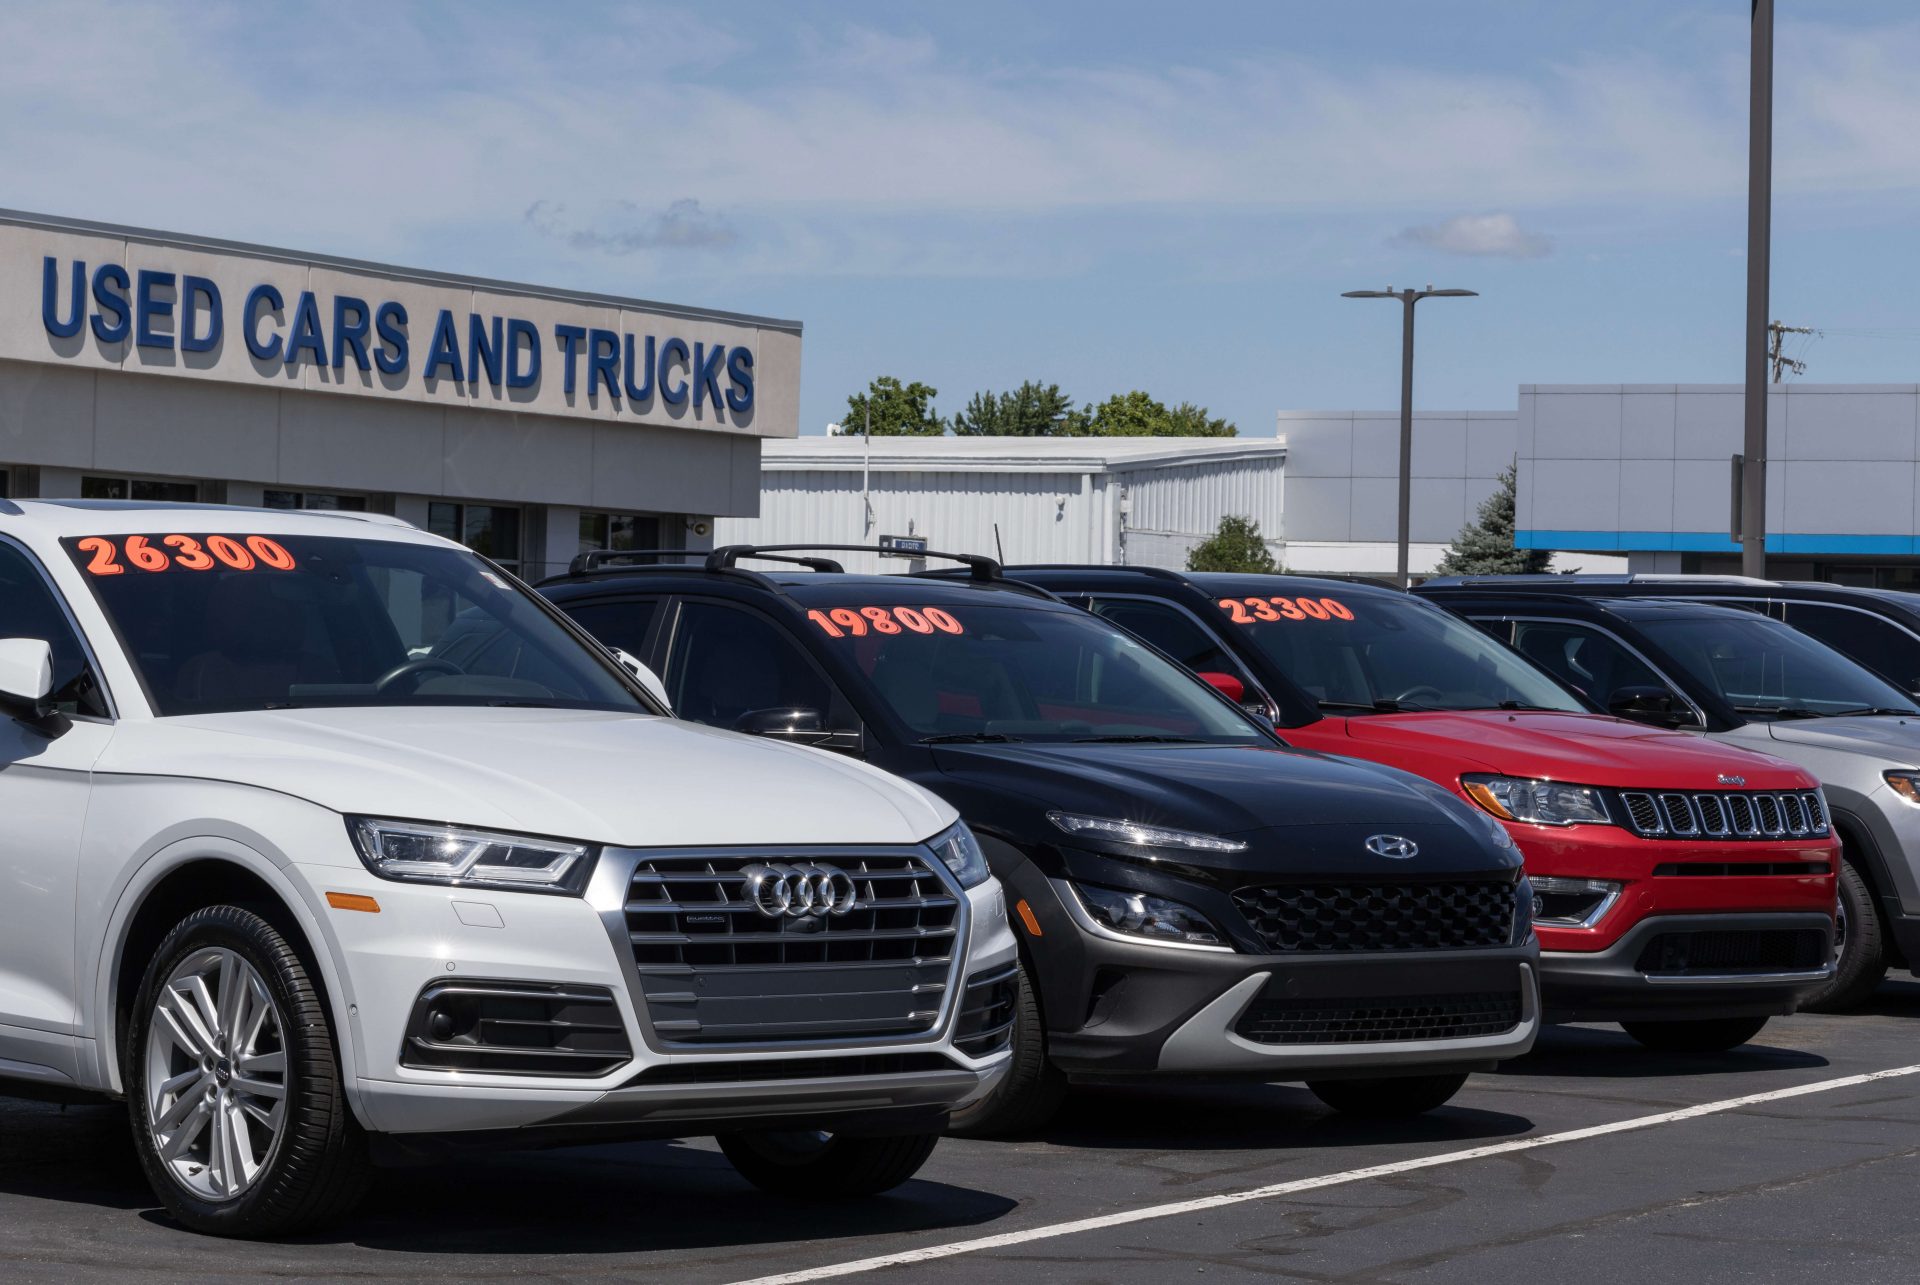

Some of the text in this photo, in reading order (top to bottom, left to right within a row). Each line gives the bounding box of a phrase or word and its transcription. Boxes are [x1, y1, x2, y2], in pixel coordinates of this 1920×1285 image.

[41, 255, 755, 413] USED CARS AND TRUCKS
[77, 533, 296, 577] 26300
[807, 606, 964, 638] 19800
[1218, 596, 1355, 625] 23300
